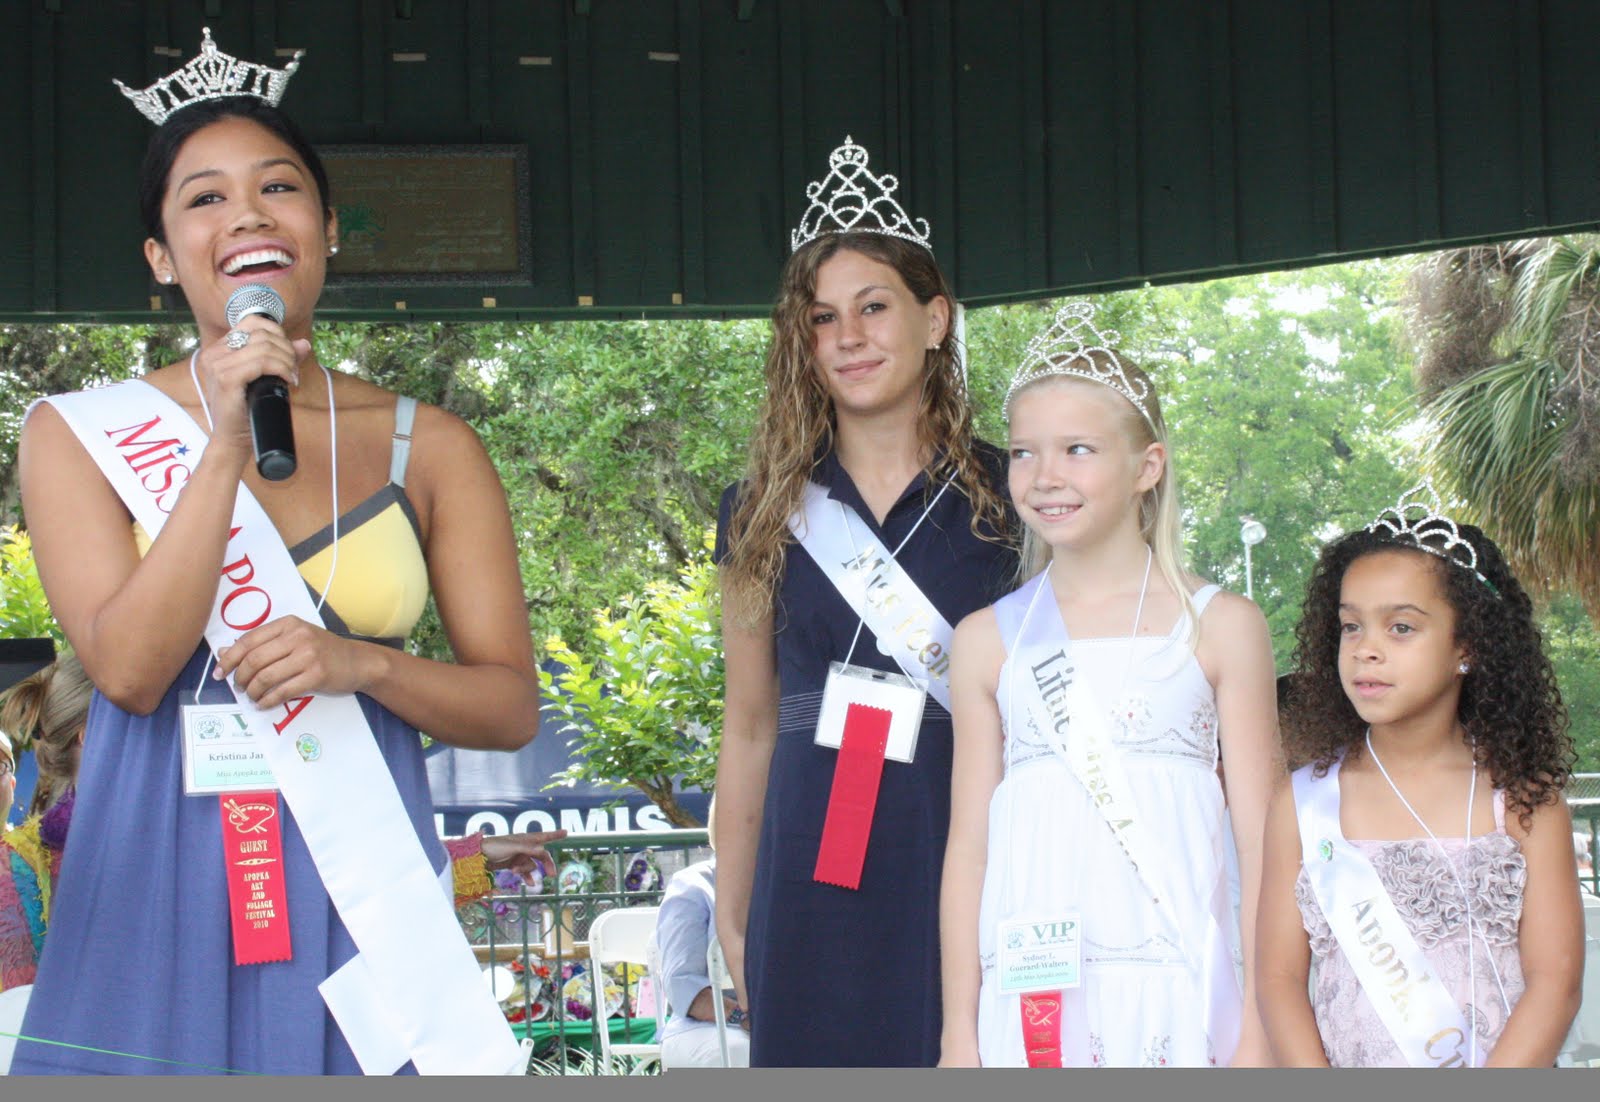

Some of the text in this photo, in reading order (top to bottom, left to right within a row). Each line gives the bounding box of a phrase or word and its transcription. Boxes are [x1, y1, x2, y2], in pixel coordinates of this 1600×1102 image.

[209, 752, 247, 761] Kristina
[240, 839, 268, 853] GUEST
[243, 871, 270, 882] APOPKA
[251, 882, 264, 891] ART
[252, 891, 265, 900] AND
[246, 900, 273, 910] FOLIAGE
[245, 909, 275, 920] FESTIVAL
[253, 920, 269, 929] 2010
[1032, 921, 1075, 939] VIP
